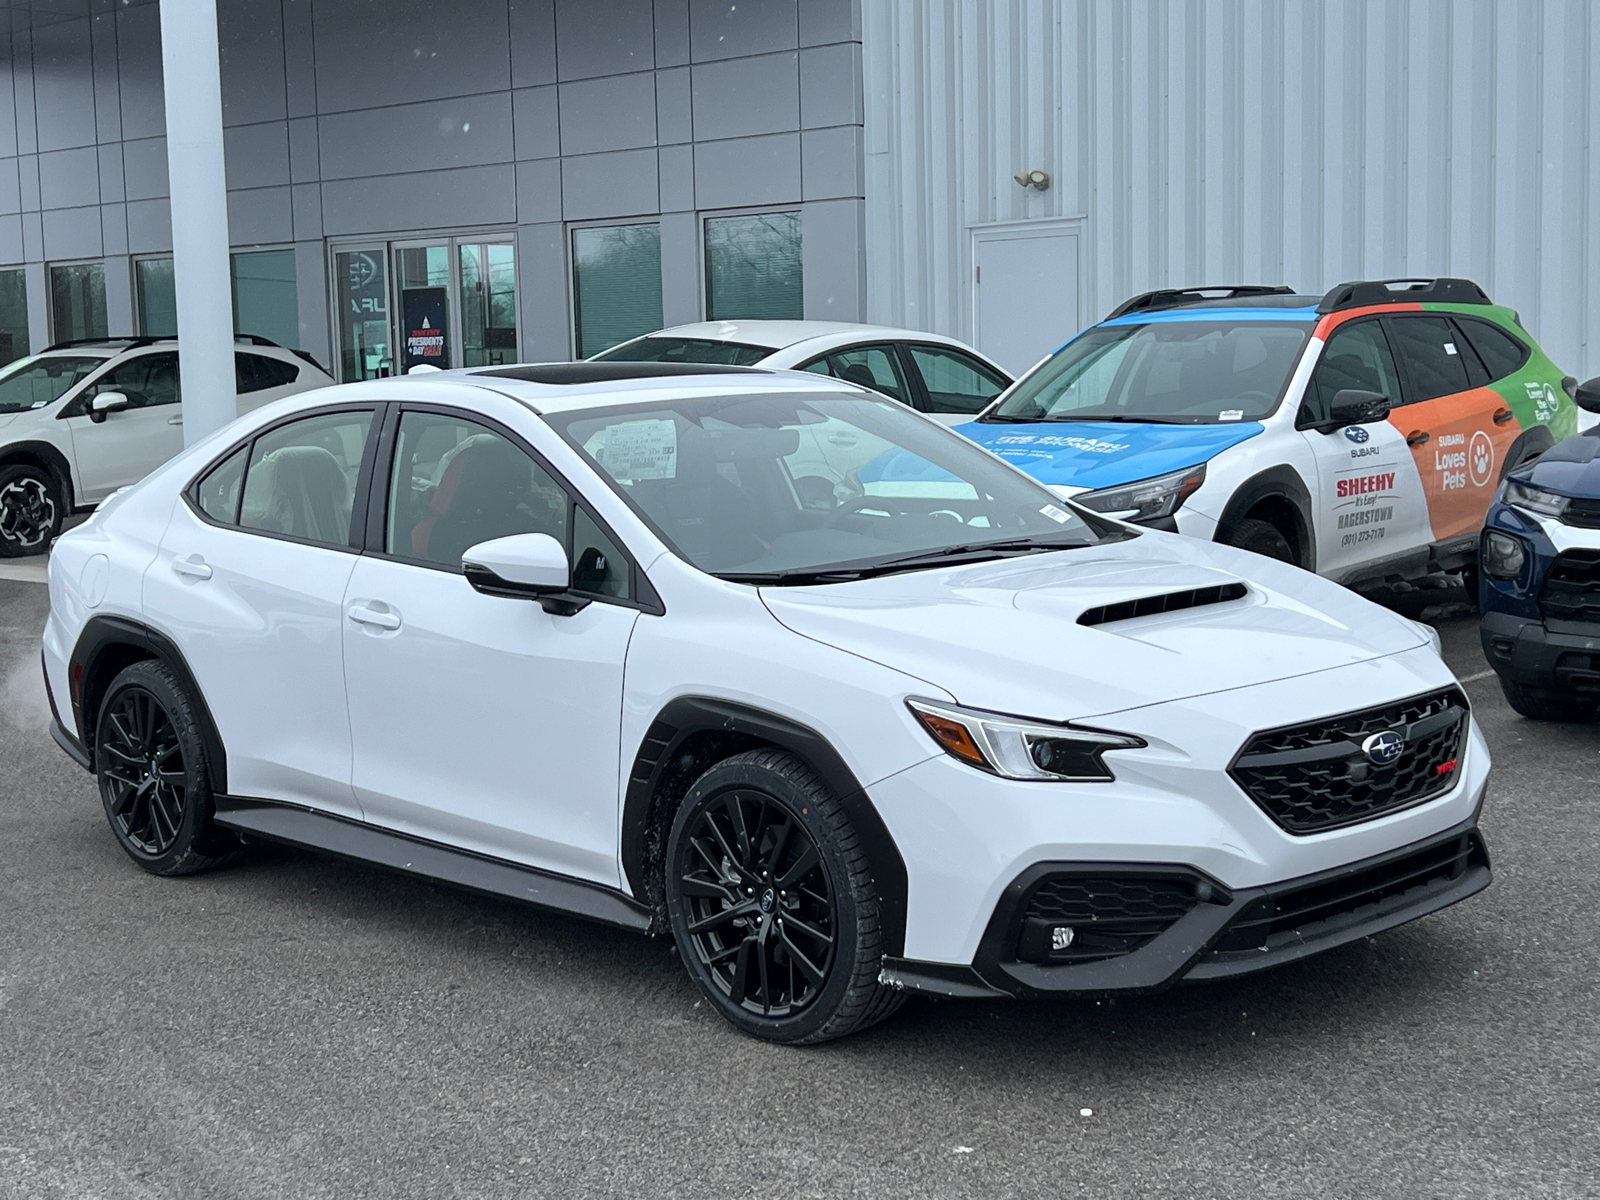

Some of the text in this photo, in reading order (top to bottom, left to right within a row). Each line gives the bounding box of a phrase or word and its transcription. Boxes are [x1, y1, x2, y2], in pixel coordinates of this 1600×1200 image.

[1438, 433, 1465, 447] SUBARU
[1351, 446, 1380, 458] SUBARU
[1435, 450, 1466, 471] Loves
[1337, 472, 1395, 498] SHEEHY
[1443, 471, 1466, 491] Pets
[1337, 506, 1394, 530] HAGERSTOWN
[1341, 527, 1385, 548] (301) 273-7170
